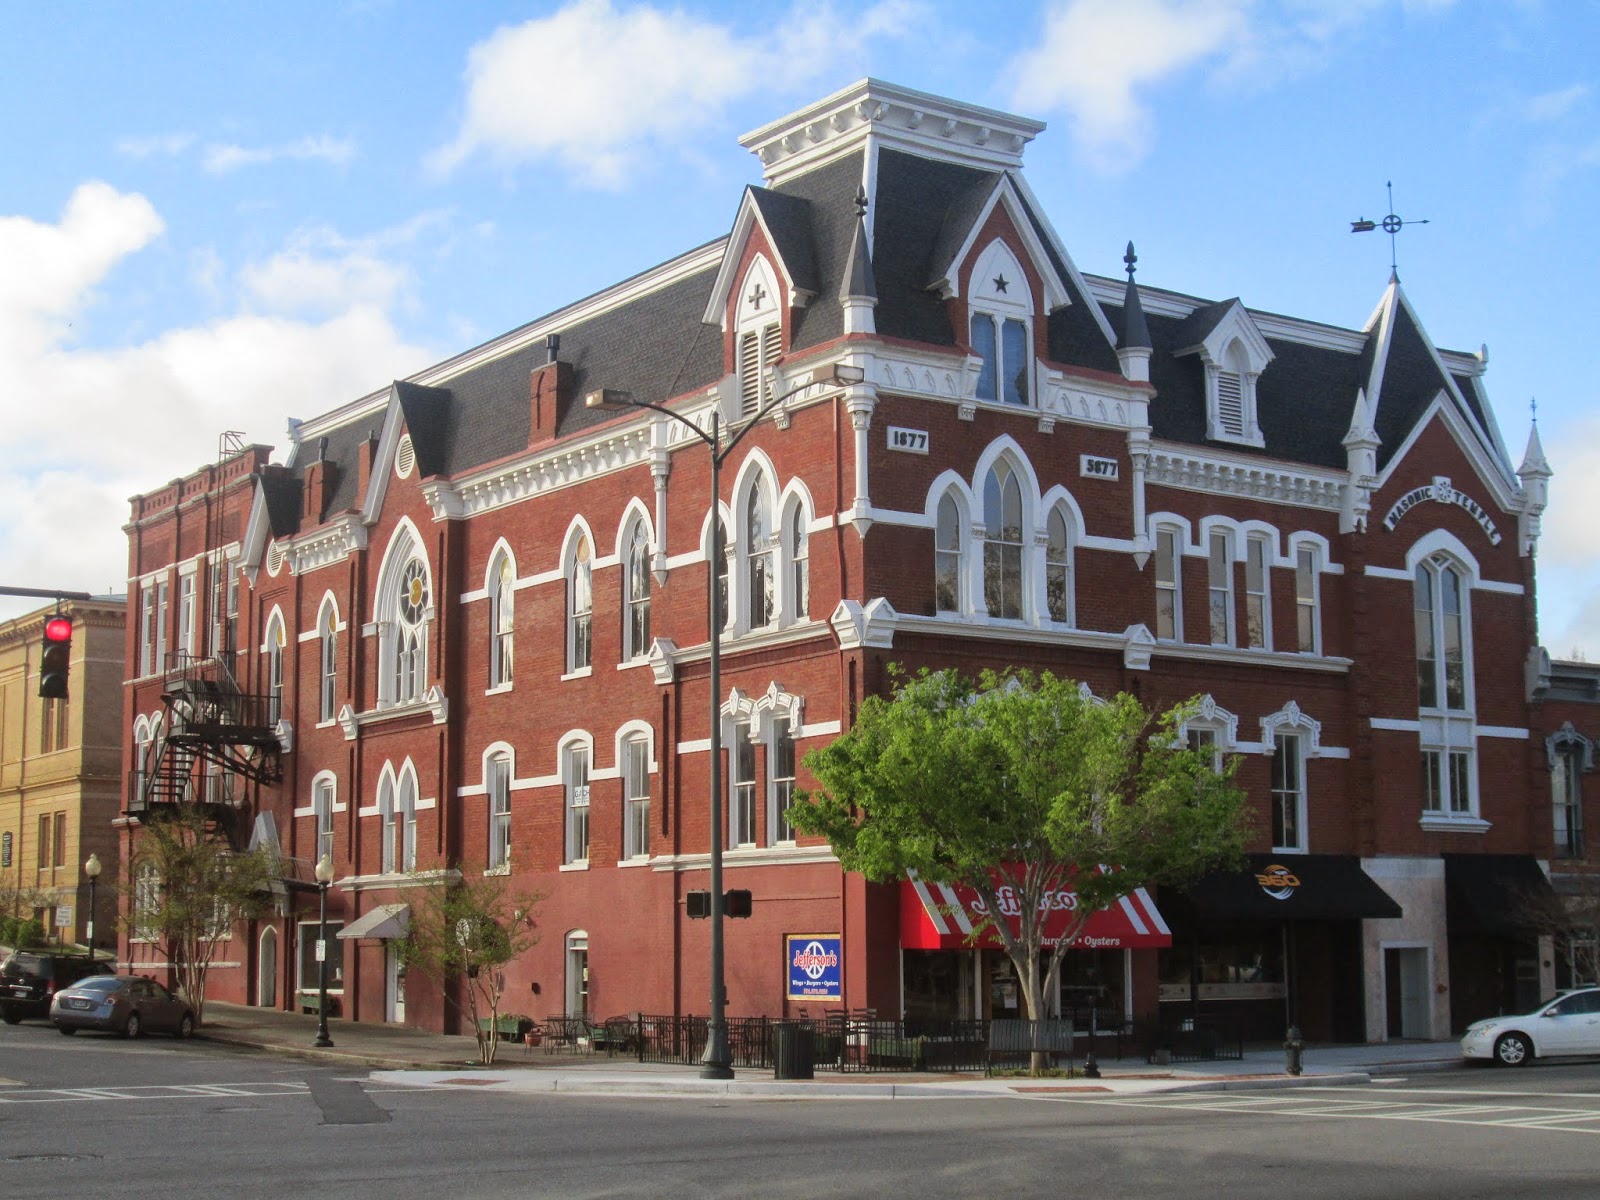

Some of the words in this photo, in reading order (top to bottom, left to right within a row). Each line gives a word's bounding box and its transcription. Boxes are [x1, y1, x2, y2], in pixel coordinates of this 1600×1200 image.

[894, 430, 927, 449] 1877
[1087, 459, 1117, 476] 5877
[1388, 488, 1433, 526] MASONIC
[1454, 491, 1499, 539] TEMPLE
[1254, 874, 1301, 887] 360
[1084, 936, 1120, 948] Oysters
[793, 950, 837, 970] Jefferson's
